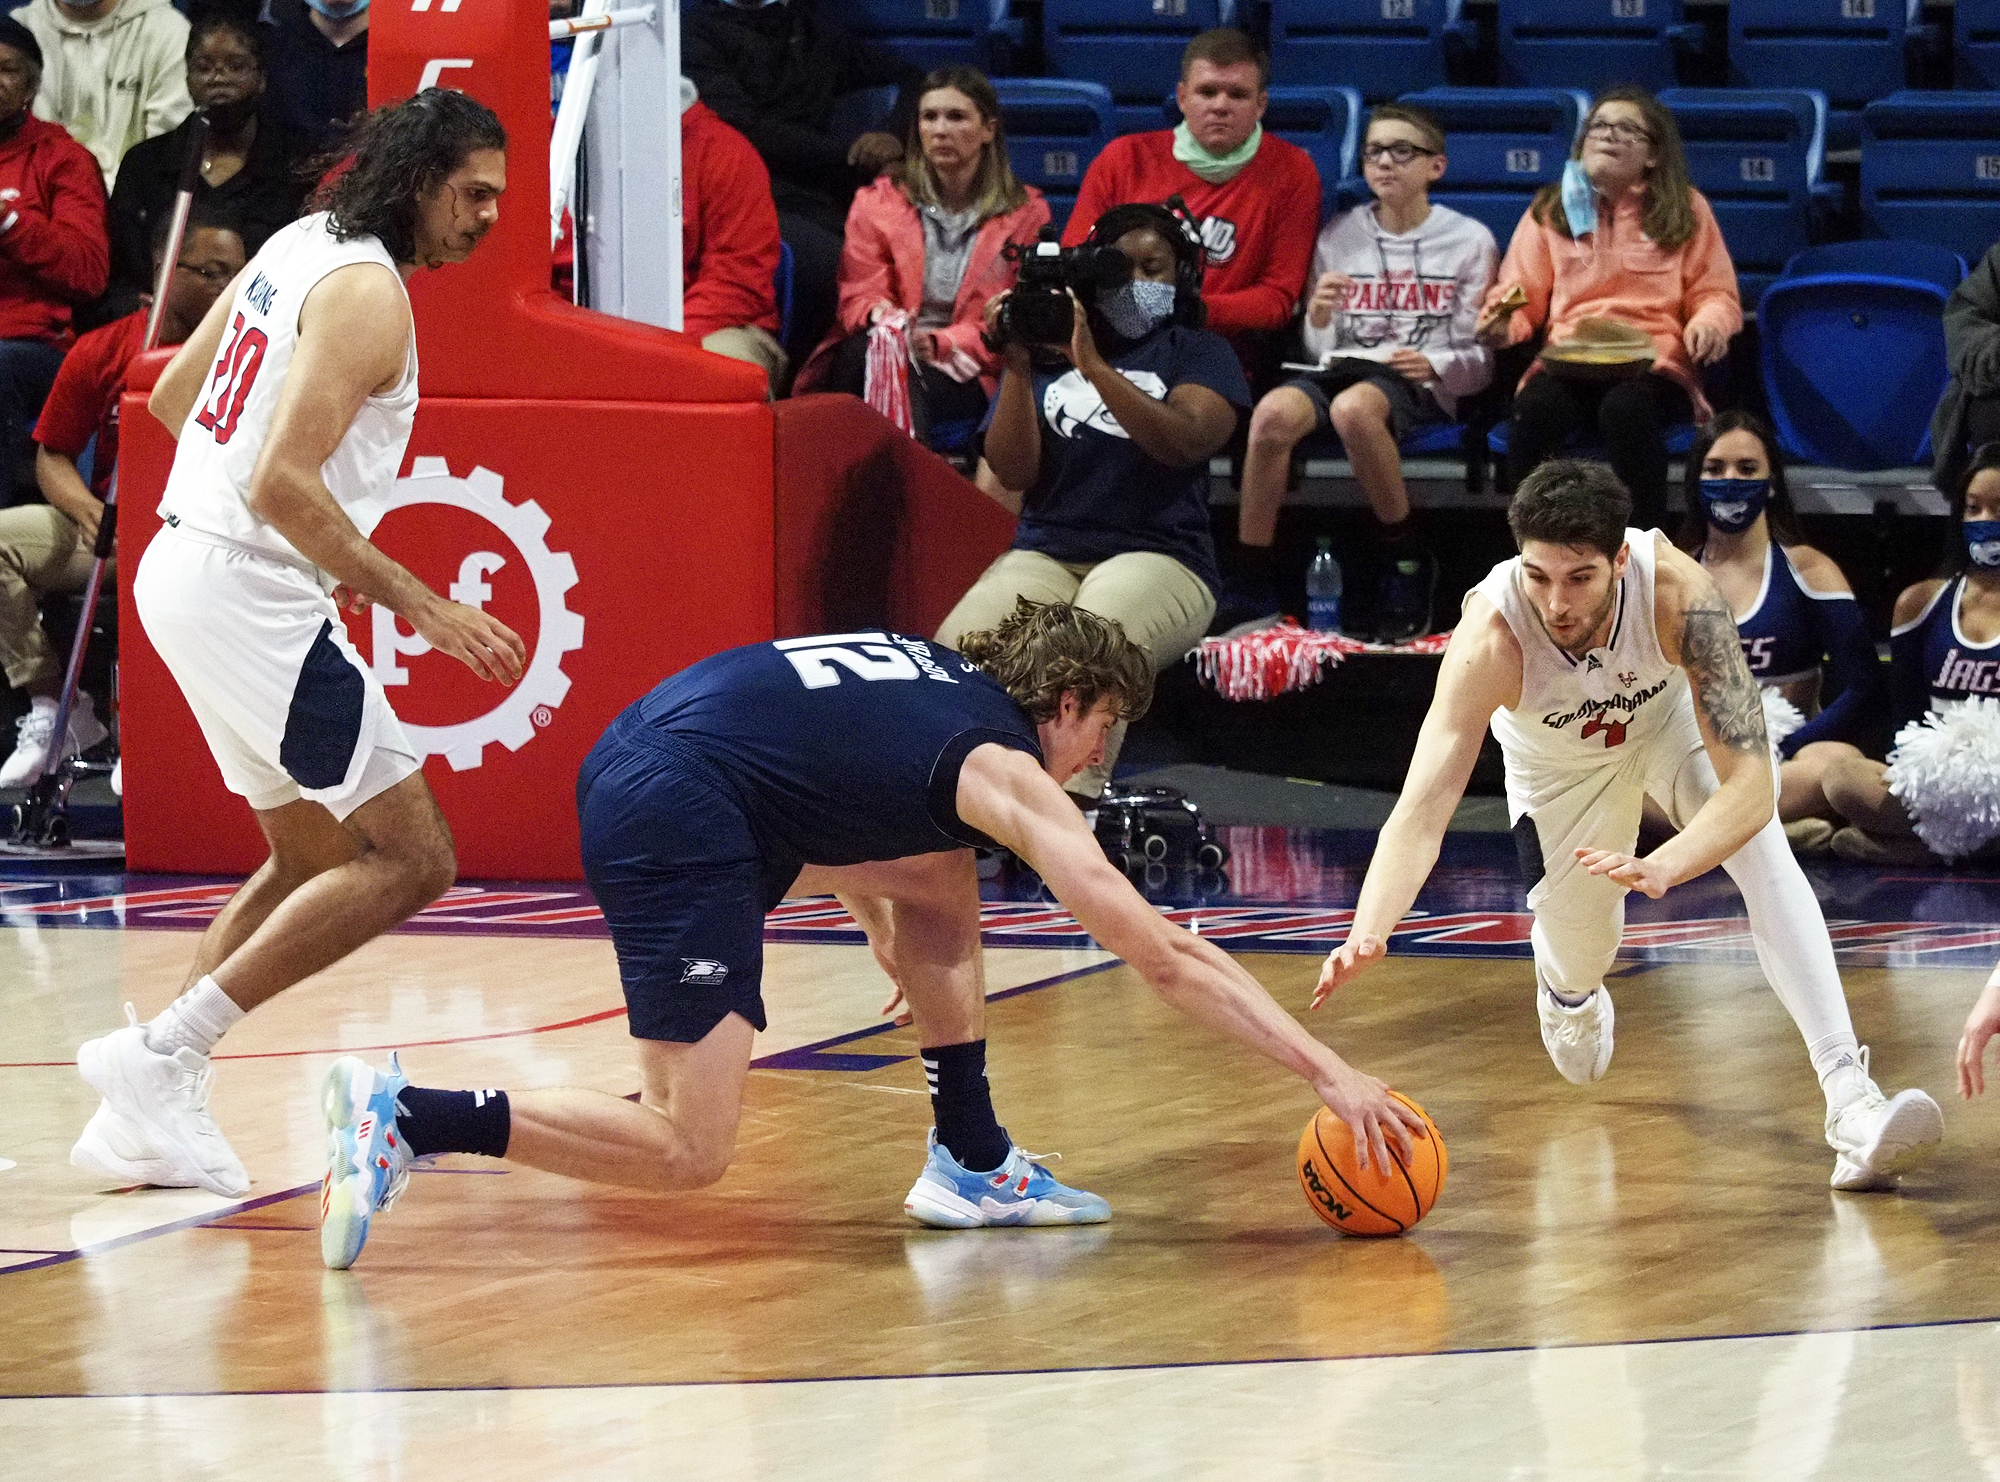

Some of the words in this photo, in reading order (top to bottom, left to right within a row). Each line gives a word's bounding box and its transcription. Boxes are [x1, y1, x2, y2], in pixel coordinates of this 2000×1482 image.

[1514, 152, 1531, 170] 13
[1748, 161, 1765, 178] 14
[1340, 282, 1456, 314] PARTANS
[194, 310, 269, 446] 20
[772, 632, 921, 690] 12
[1302, 1158, 1353, 1221] NCAA
